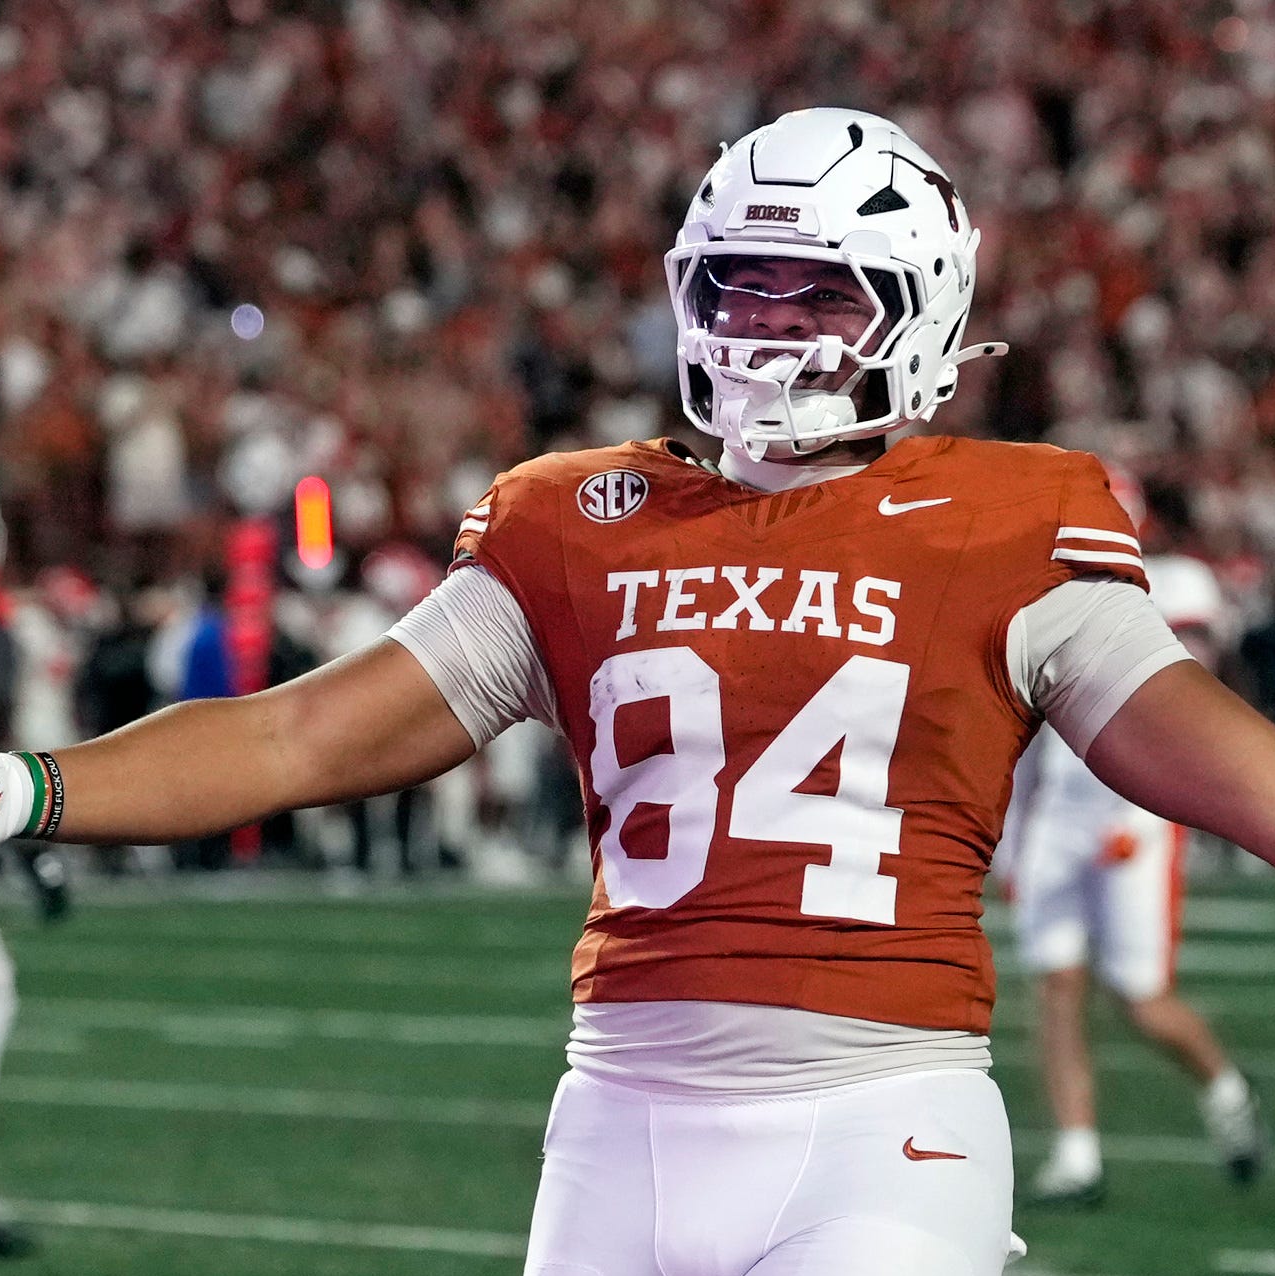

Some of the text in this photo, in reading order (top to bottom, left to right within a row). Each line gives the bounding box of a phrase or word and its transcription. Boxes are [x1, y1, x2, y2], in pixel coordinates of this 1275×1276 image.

[745, 204, 801, 223] HORNS
[583, 472, 642, 519] SEC
[607, 565, 901, 646] TEXAS
[44, 756, 59, 776] OUT
[52, 776, 63, 803] FUCK
[590, 645, 911, 926] 84
[51, 804, 62, 823] THE
